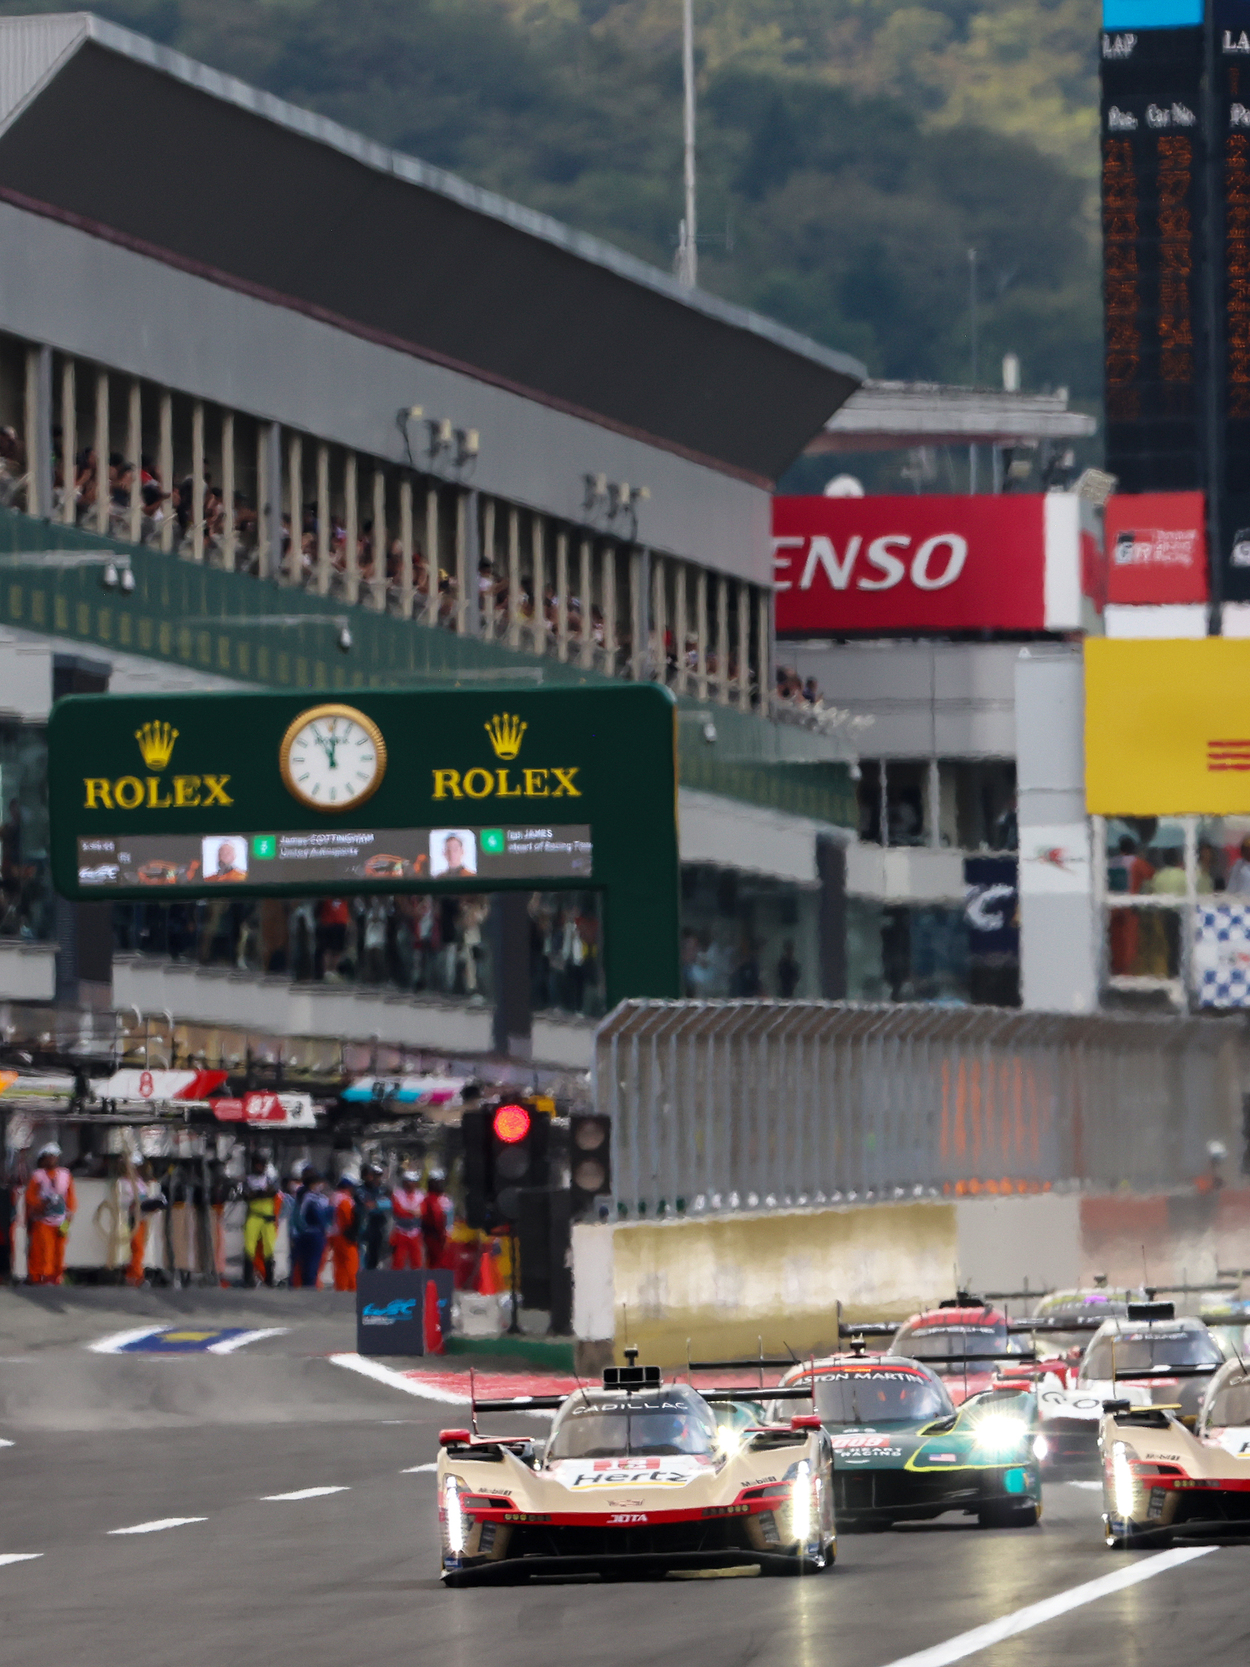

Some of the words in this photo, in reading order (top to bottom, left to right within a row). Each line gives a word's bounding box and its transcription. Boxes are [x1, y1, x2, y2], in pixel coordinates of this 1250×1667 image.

[1102, 33, 1138, 59] LAP
[772, 533, 968, 590] ENSO
[83, 774, 234, 810] ROLEX
[432, 767, 582, 801] ROLEX
[139, 1071, 153, 1097] 8
[854, 1372, 925, 1385] MARTIN
[572, 1402, 688, 1415] CADILLAC
[573, 1471, 691, 1486] Hertz
